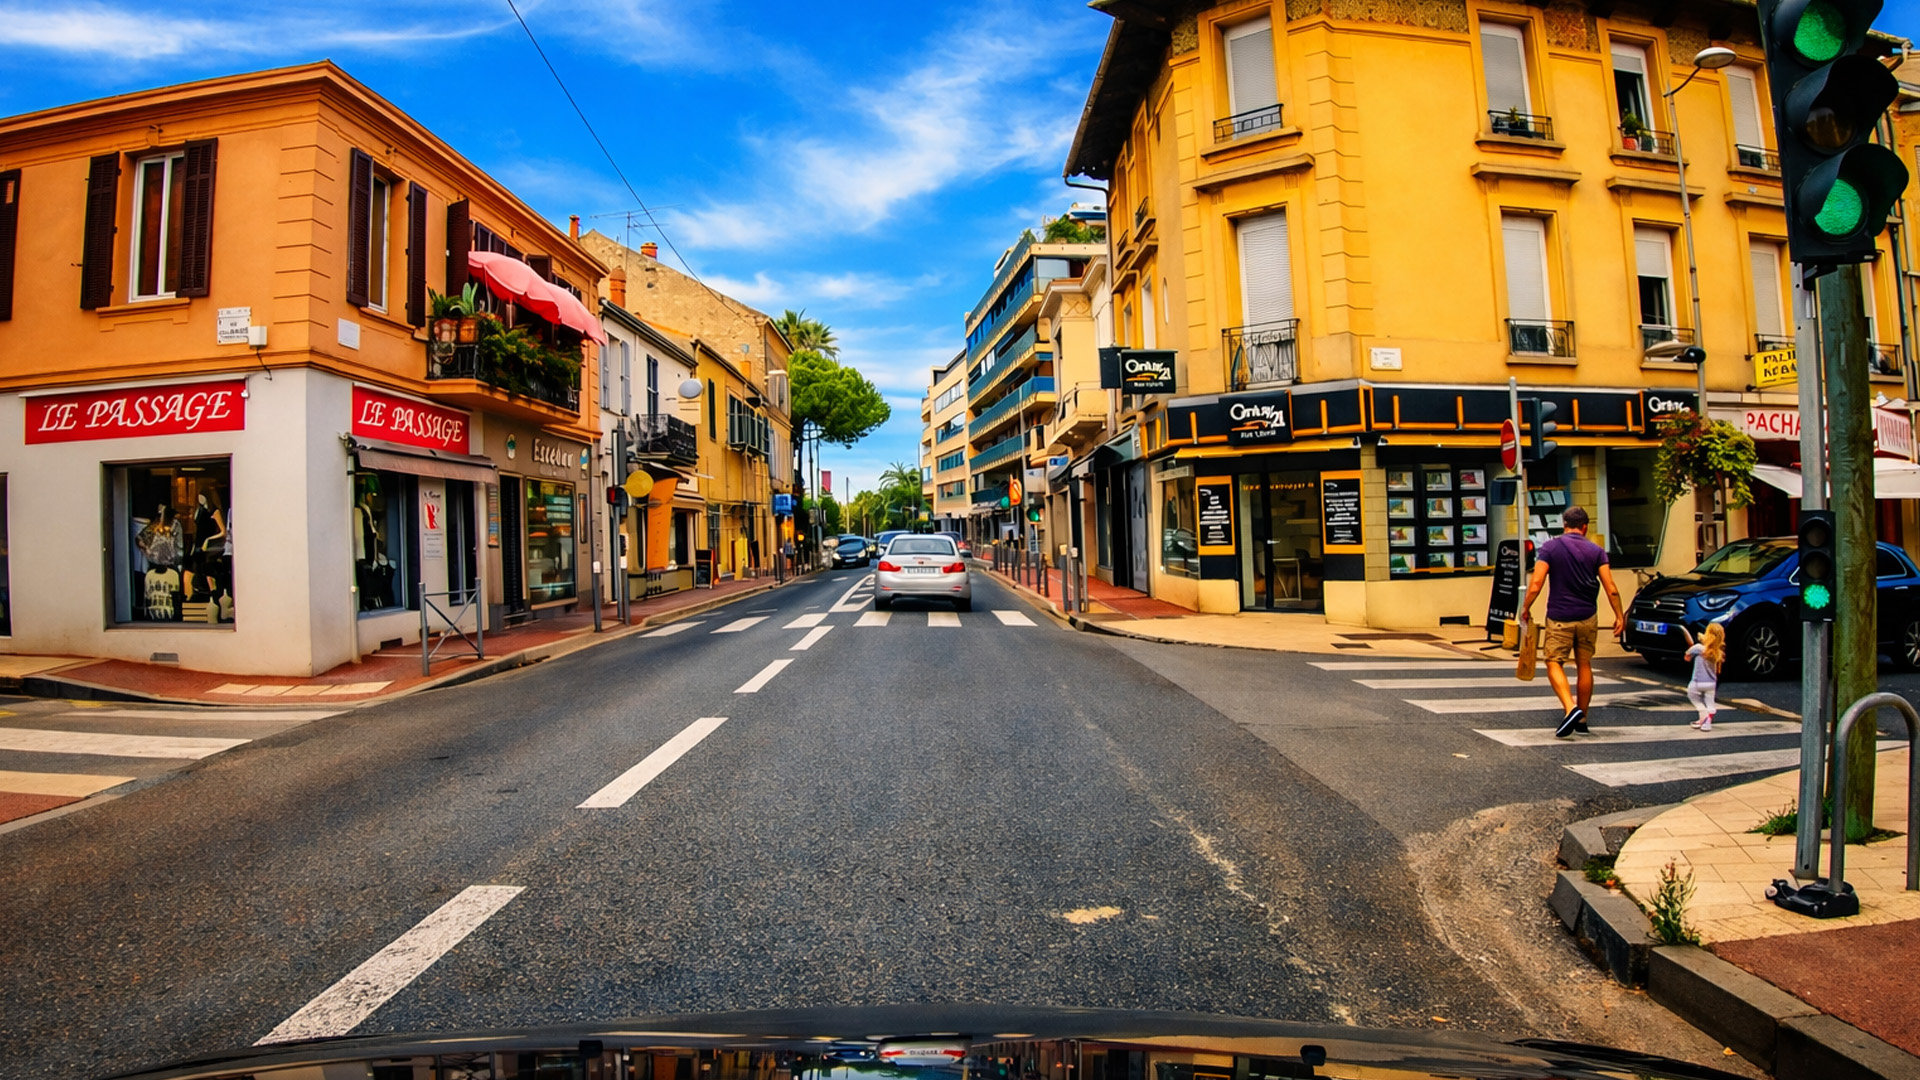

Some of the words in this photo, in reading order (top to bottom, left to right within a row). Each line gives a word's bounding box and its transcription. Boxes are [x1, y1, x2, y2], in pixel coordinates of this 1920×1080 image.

[37, 402, 79, 432] LE
[84, 390, 233, 430] PASSAGE
[357, 399, 387, 427] LE
[390, 407, 464, 447] PASSAGE
[1230, 403, 1275, 420] Century
[1270, 409, 1286, 429] 21
